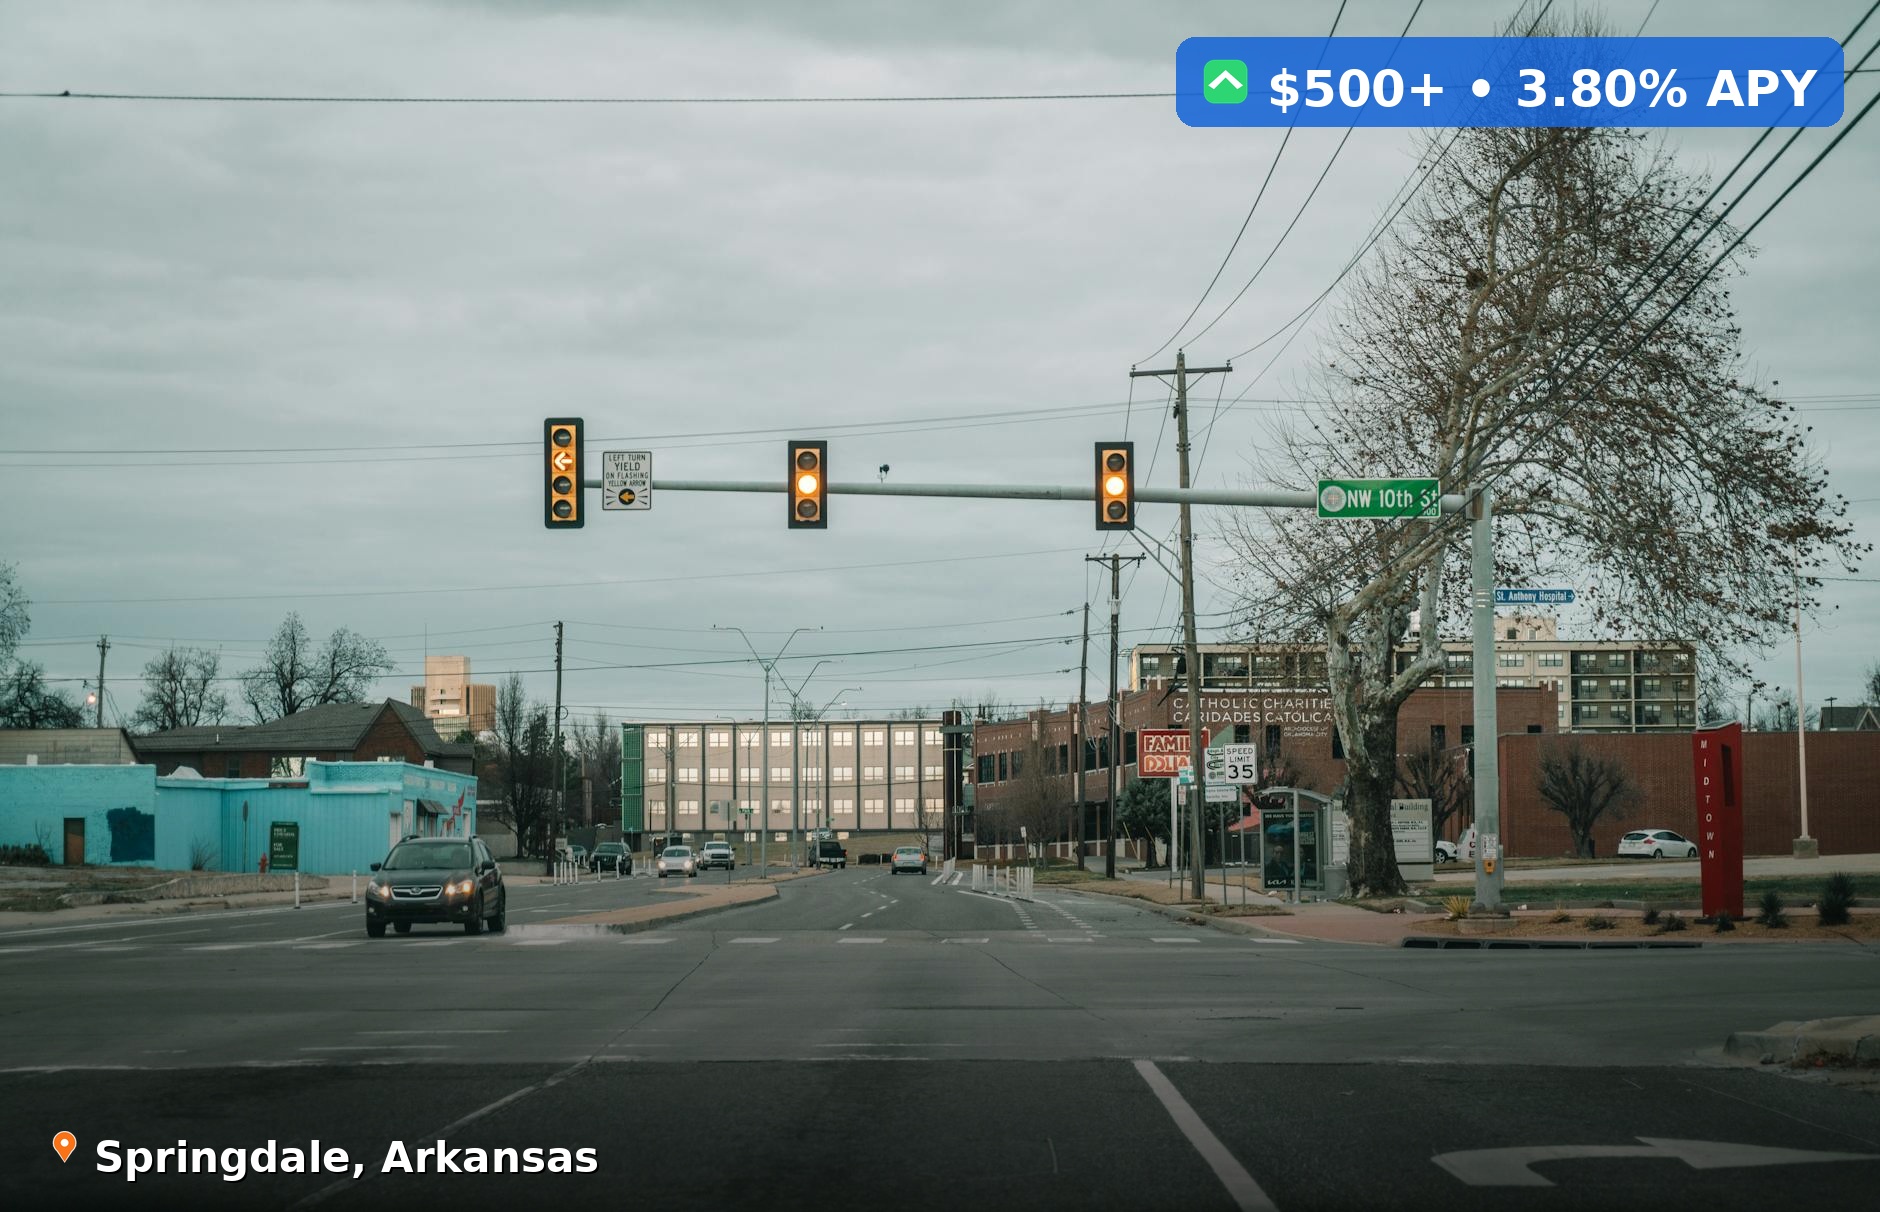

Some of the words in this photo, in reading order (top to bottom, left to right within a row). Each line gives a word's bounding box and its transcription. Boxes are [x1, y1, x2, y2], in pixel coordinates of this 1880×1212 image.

[608, 454, 625, 462] LEFT
[628, 454, 646, 462] TURN
[614, 462, 641, 471] YIELD
[1347, 489, 1372, 508] NW
[1379, 488, 1413, 508] 10th
[1420, 488, 1438, 508] St
[1496, 591, 1506, 601] St.
[1508, 591, 1536, 602] Anthony
[1539, 591, 1567, 602] Hospital
[1263, 698, 1333, 709] CHARITIE
[1265, 710, 1333, 722] CATÓLICA
[1144, 735, 1203, 752] FAMIL
[1226, 747, 1254, 755] SPEED
[1144, 755, 1191, 772] DOLLA
[1228, 764, 1254, 779] 35
[1700, 739, 1715, 859] MIDTOWN
